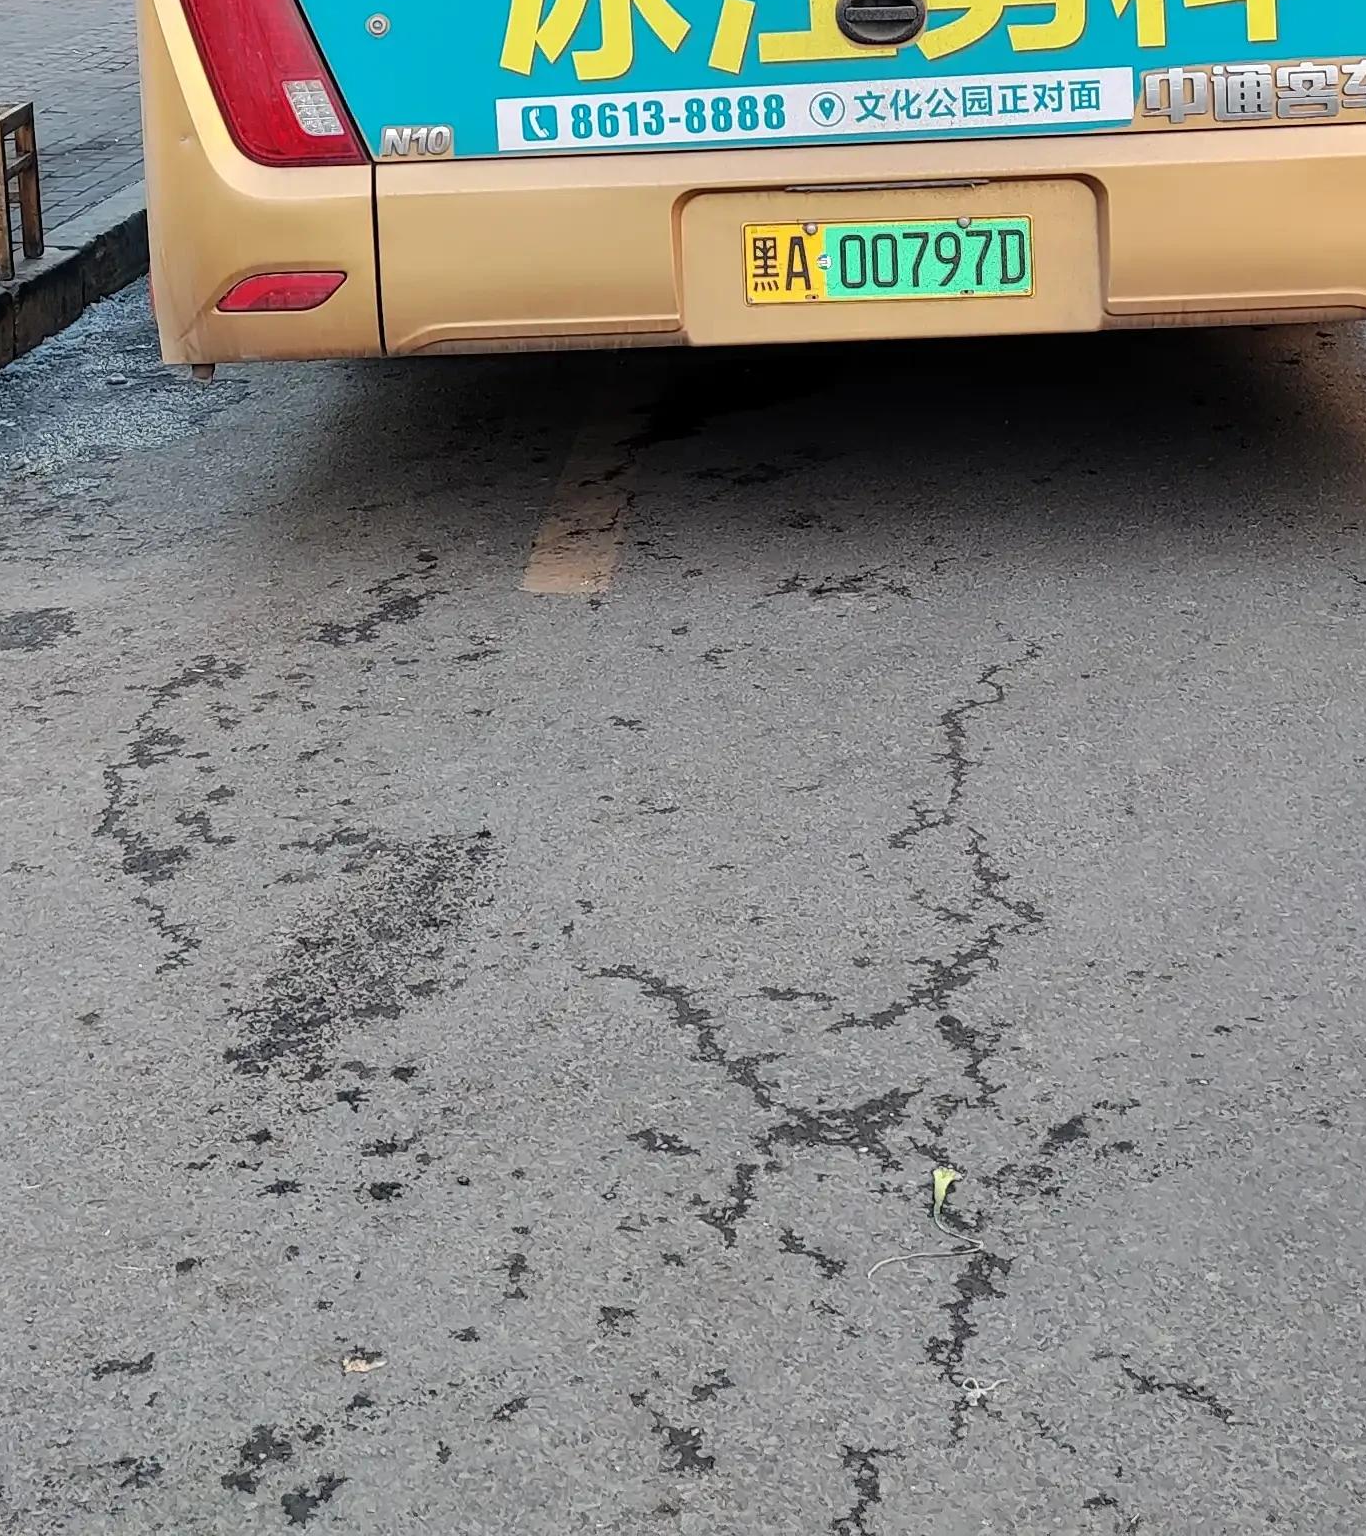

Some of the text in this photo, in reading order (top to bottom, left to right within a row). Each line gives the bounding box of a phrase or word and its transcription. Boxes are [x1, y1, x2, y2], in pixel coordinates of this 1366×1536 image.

[571, 79, 1102, 140] 8613-8888 文化公园正对面
[381, 125, 452, 157] N10
